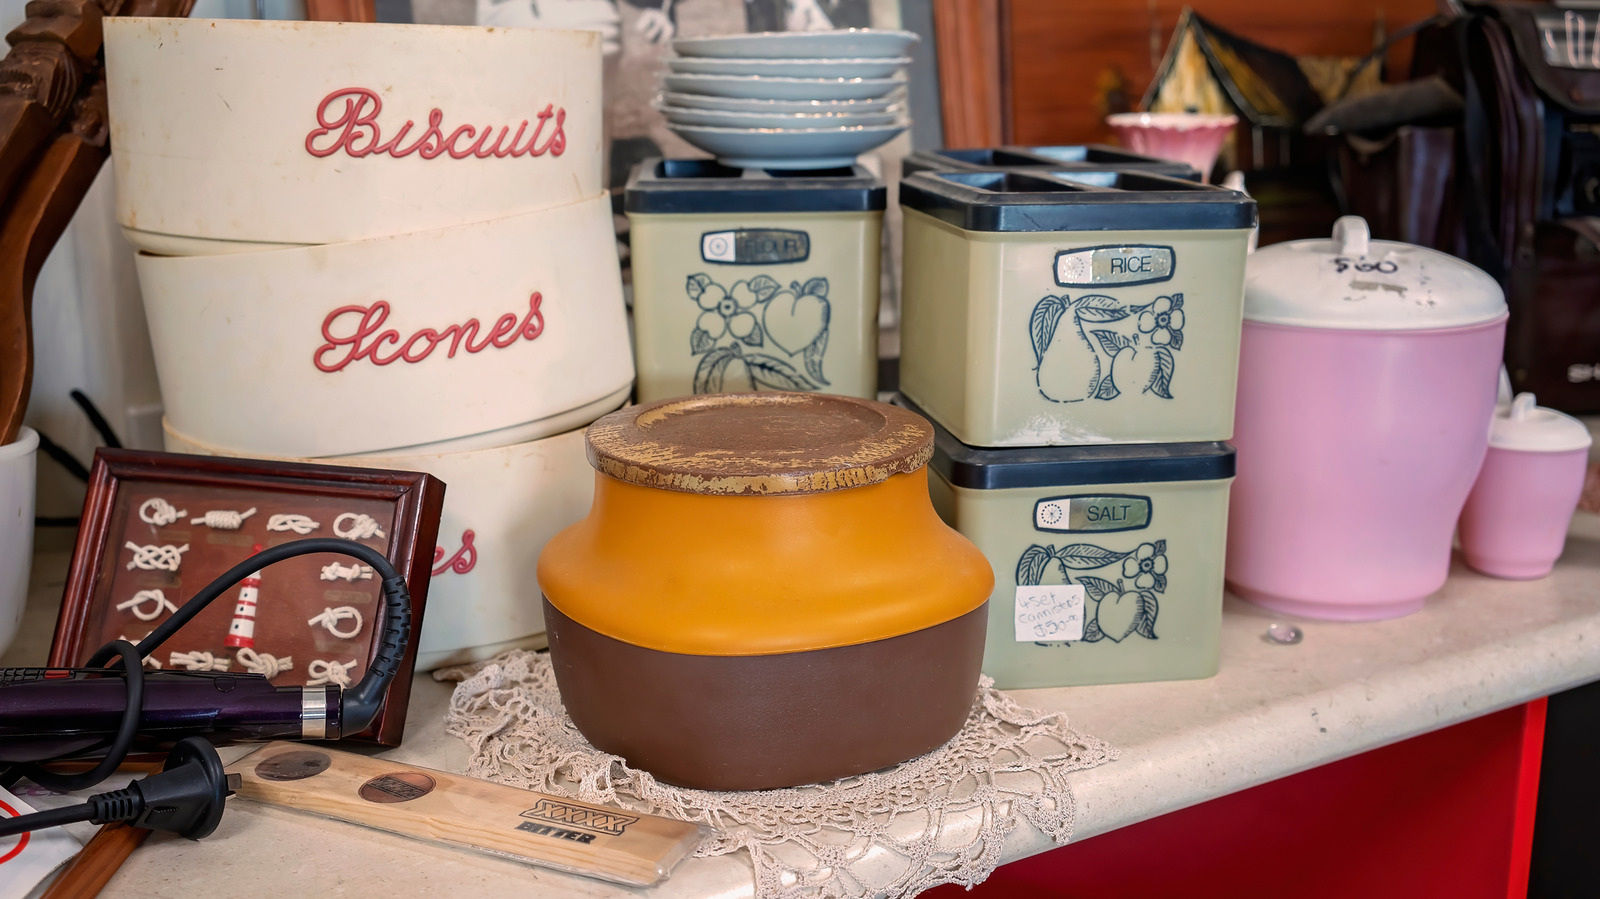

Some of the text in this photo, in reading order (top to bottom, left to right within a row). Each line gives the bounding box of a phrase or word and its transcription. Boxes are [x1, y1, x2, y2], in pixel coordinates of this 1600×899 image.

[305, 87, 566, 159] Biscuits
[1111, 255, 1152, 274] RICE
[313, 292, 544, 374] Scones
[1087, 505, 1131, 522] SALT
[431, 529, 477, 576] es
[514, 820, 597, 844] BITTER
[522, 799, 636, 835] XXXX
